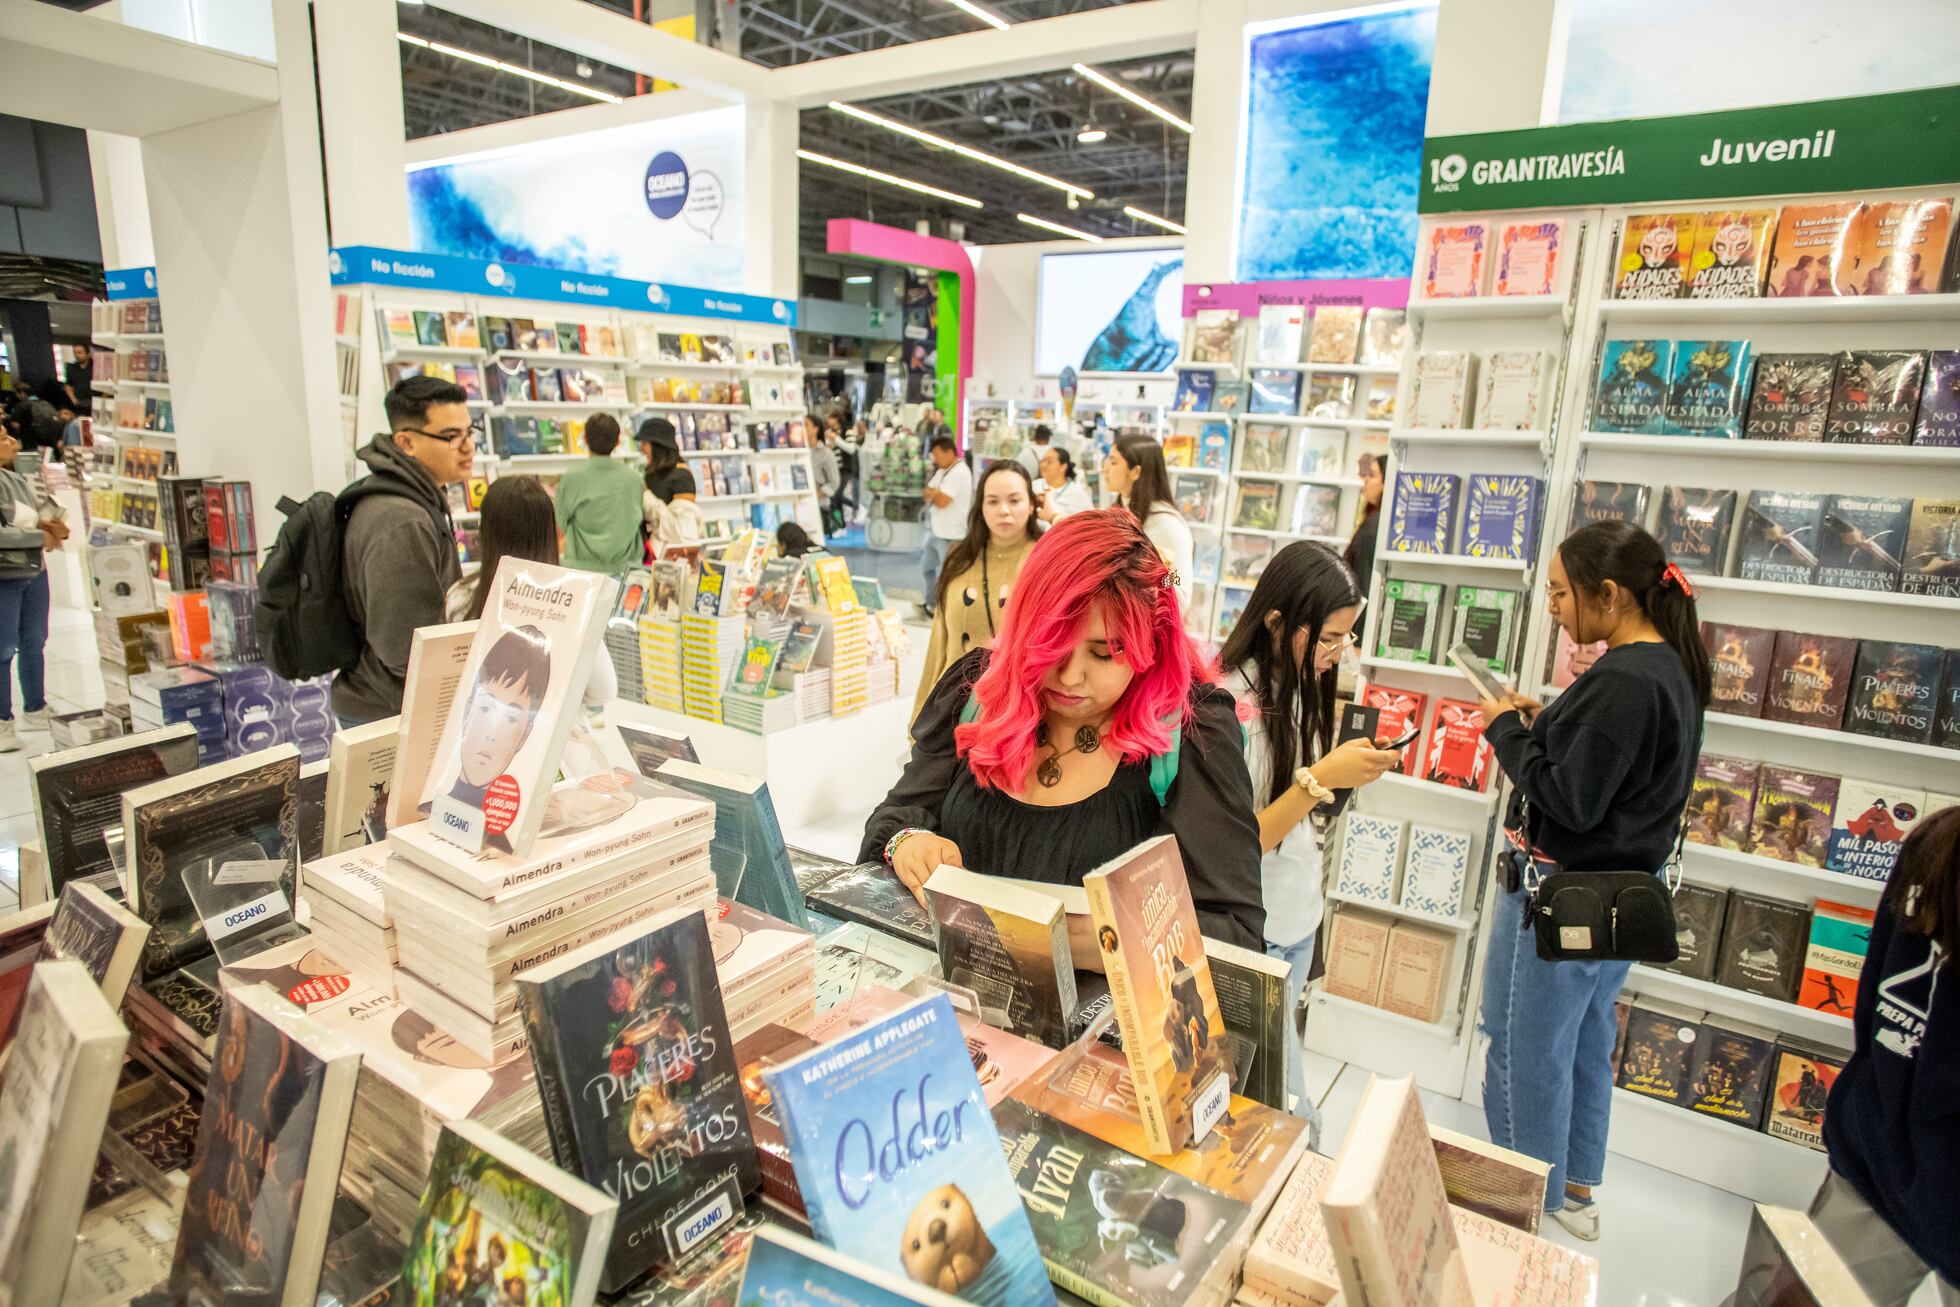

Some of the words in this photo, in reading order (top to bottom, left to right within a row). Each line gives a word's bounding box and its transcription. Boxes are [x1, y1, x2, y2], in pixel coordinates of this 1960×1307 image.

[1701, 129, 1836, 166] Juvenil
[1472, 145, 1626, 185] GRANTRAVESÍA
[371, 257, 391, 274] No
[395, 260, 435, 279] ficción
[1621, 267, 1682, 288] DEIDADES
[1693, 265, 1756, 288] DEIDADES
[560, 280, 577, 292] No
[579, 281, 609, 298] ficción
[1683, 388, 1726, 398] ALMA
[1600, 405, 1662, 416] ESPADA
[1670, 405, 1735, 417] ESPADA
[1837, 402, 1910, 413] SOMBRA
[1748, 420, 1823, 434] ZORRO
[1818, 575, 1835, 586] DE
[1839, 577, 1893, 592] ESPADAS
[1819, 566, 1894, 581] DESTRUCTORA
[506, 576, 574, 608] Almendra
[1902, 584, 1921, 595] DE
[503, 598, 546, 621] Won-pyung
[546, 608, 567, 624] Sohn
[1853, 704, 1927, 729] VIOLENTOS
[443, 811, 469, 833] OCEANO
[1837, 835, 1860, 850] MIL
[501, 859, 563, 889] Almendra
[583, 836, 630, 859] Won-pyung
[631, 829, 652, 844] Sohn
[1853, 865, 1892, 881] NOCH
[505, 904, 564, 937] Almendra
[583, 877, 628, 904] Won-pyung
[629, 869, 648, 884] Sohn
[225, 903, 267, 928] OCEANO
[510, 941, 569, 975] Almendra
[588, 914, 633, 940] Won-pyung
[634, 905, 654, 919] Sohn
[723, 977, 744, 995] pyung
[746, 1001, 764, 1015] Sohn
[802, 1039, 873, 1085] KATHERINE
[874, 1008, 938, 1051] APPLEGATE
[583, 1025, 717, 1119] PLACERES
[1633, 1074, 1654, 1083] club
[1624, 1081, 1679, 1099] medianoche
[1703, 1094, 1724, 1104] club
[1694, 1102, 1751, 1120] medianoche
[601, 1104, 739, 1200] VIOLENTOS
[835, 1073, 970, 1210] Odder
[683, 1205, 724, 1244] OCEANO
